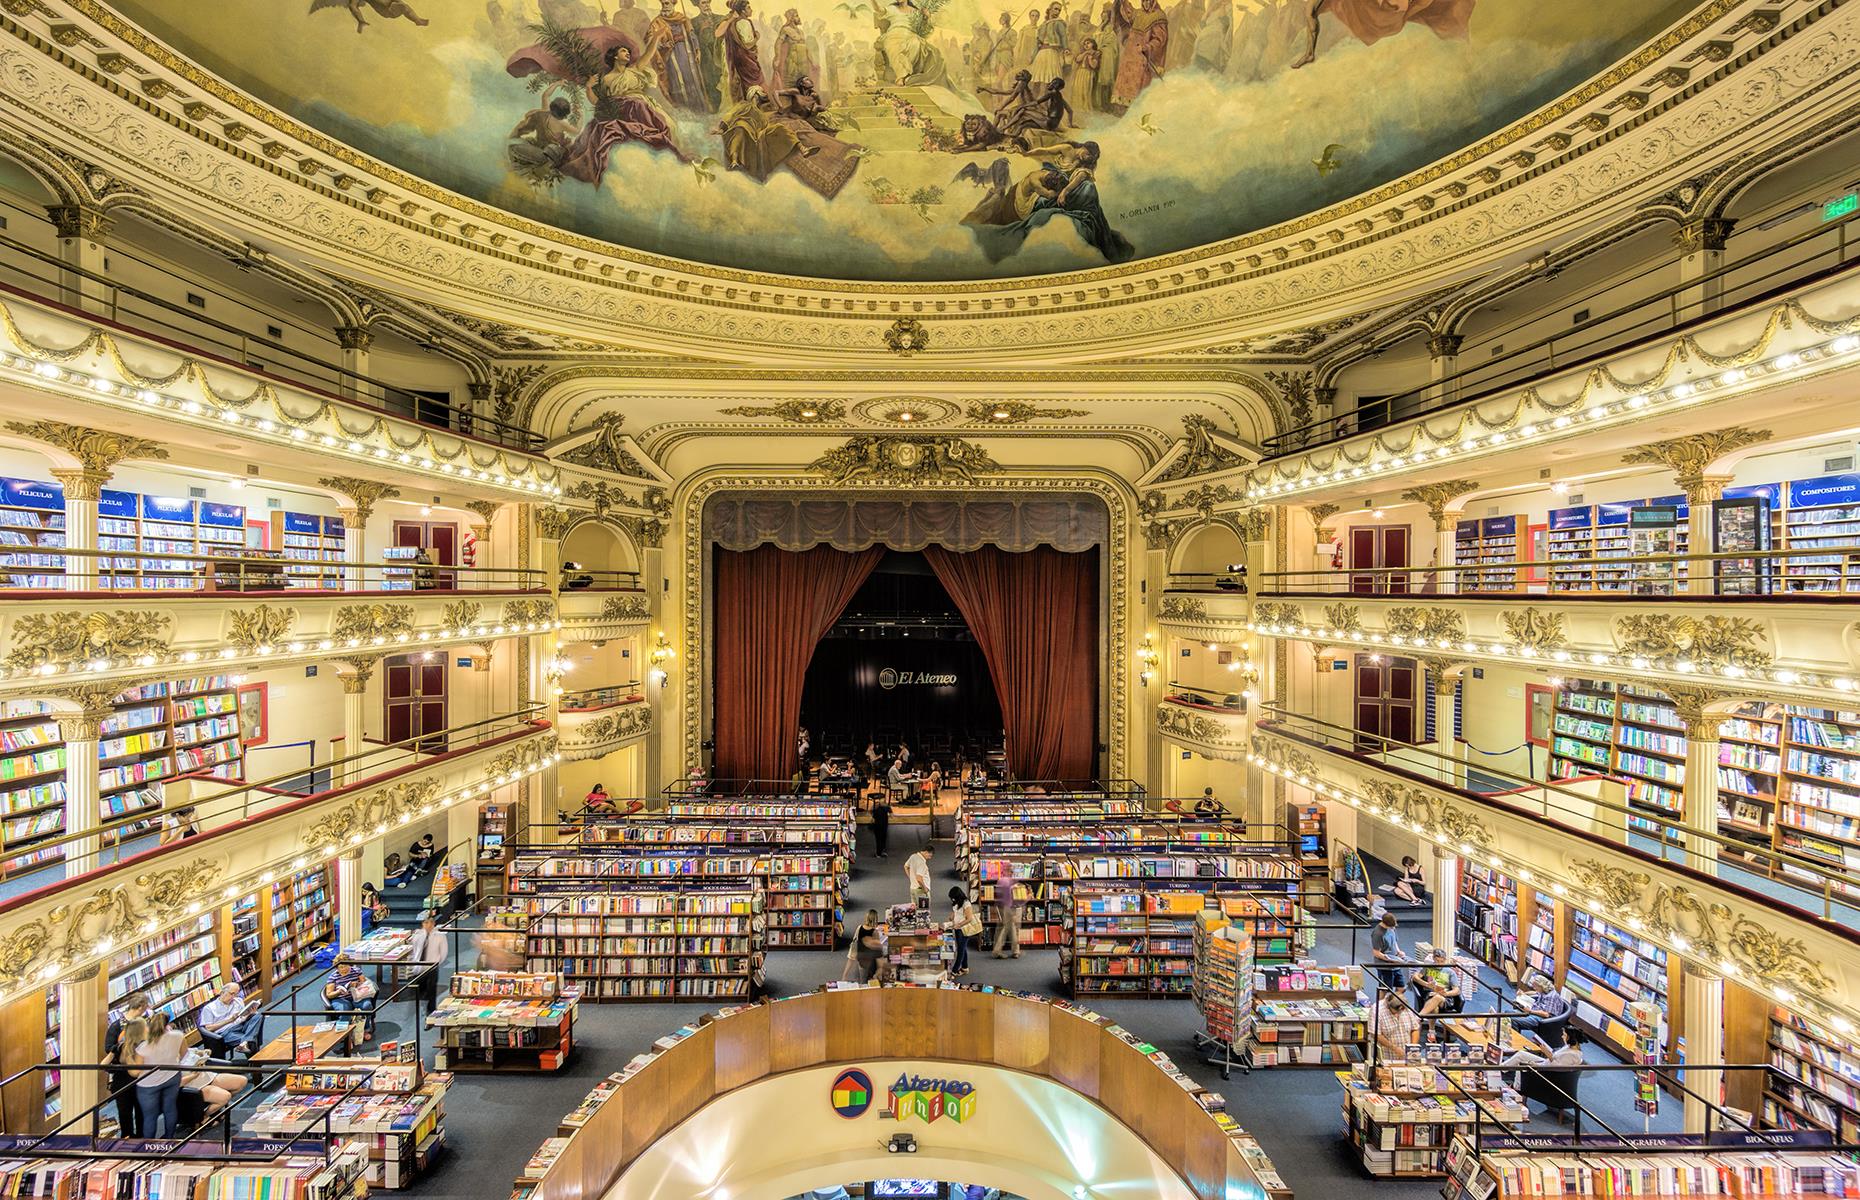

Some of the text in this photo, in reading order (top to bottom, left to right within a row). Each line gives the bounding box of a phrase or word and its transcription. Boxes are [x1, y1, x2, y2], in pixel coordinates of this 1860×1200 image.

[19, 490, 53, 499] PELICULAS
[1801, 484, 1856, 496] COMPOSITORES
[898, 671, 957, 685] El Ateneo
[891, 1072, 973, 1094] Ateneo
[1503, 1138, 1553, 1146] BIORAFIAS
[1618, 1138, 1667, 1147] BOGRAFIAS
[145, 1143, 174, 1151] POESIA
